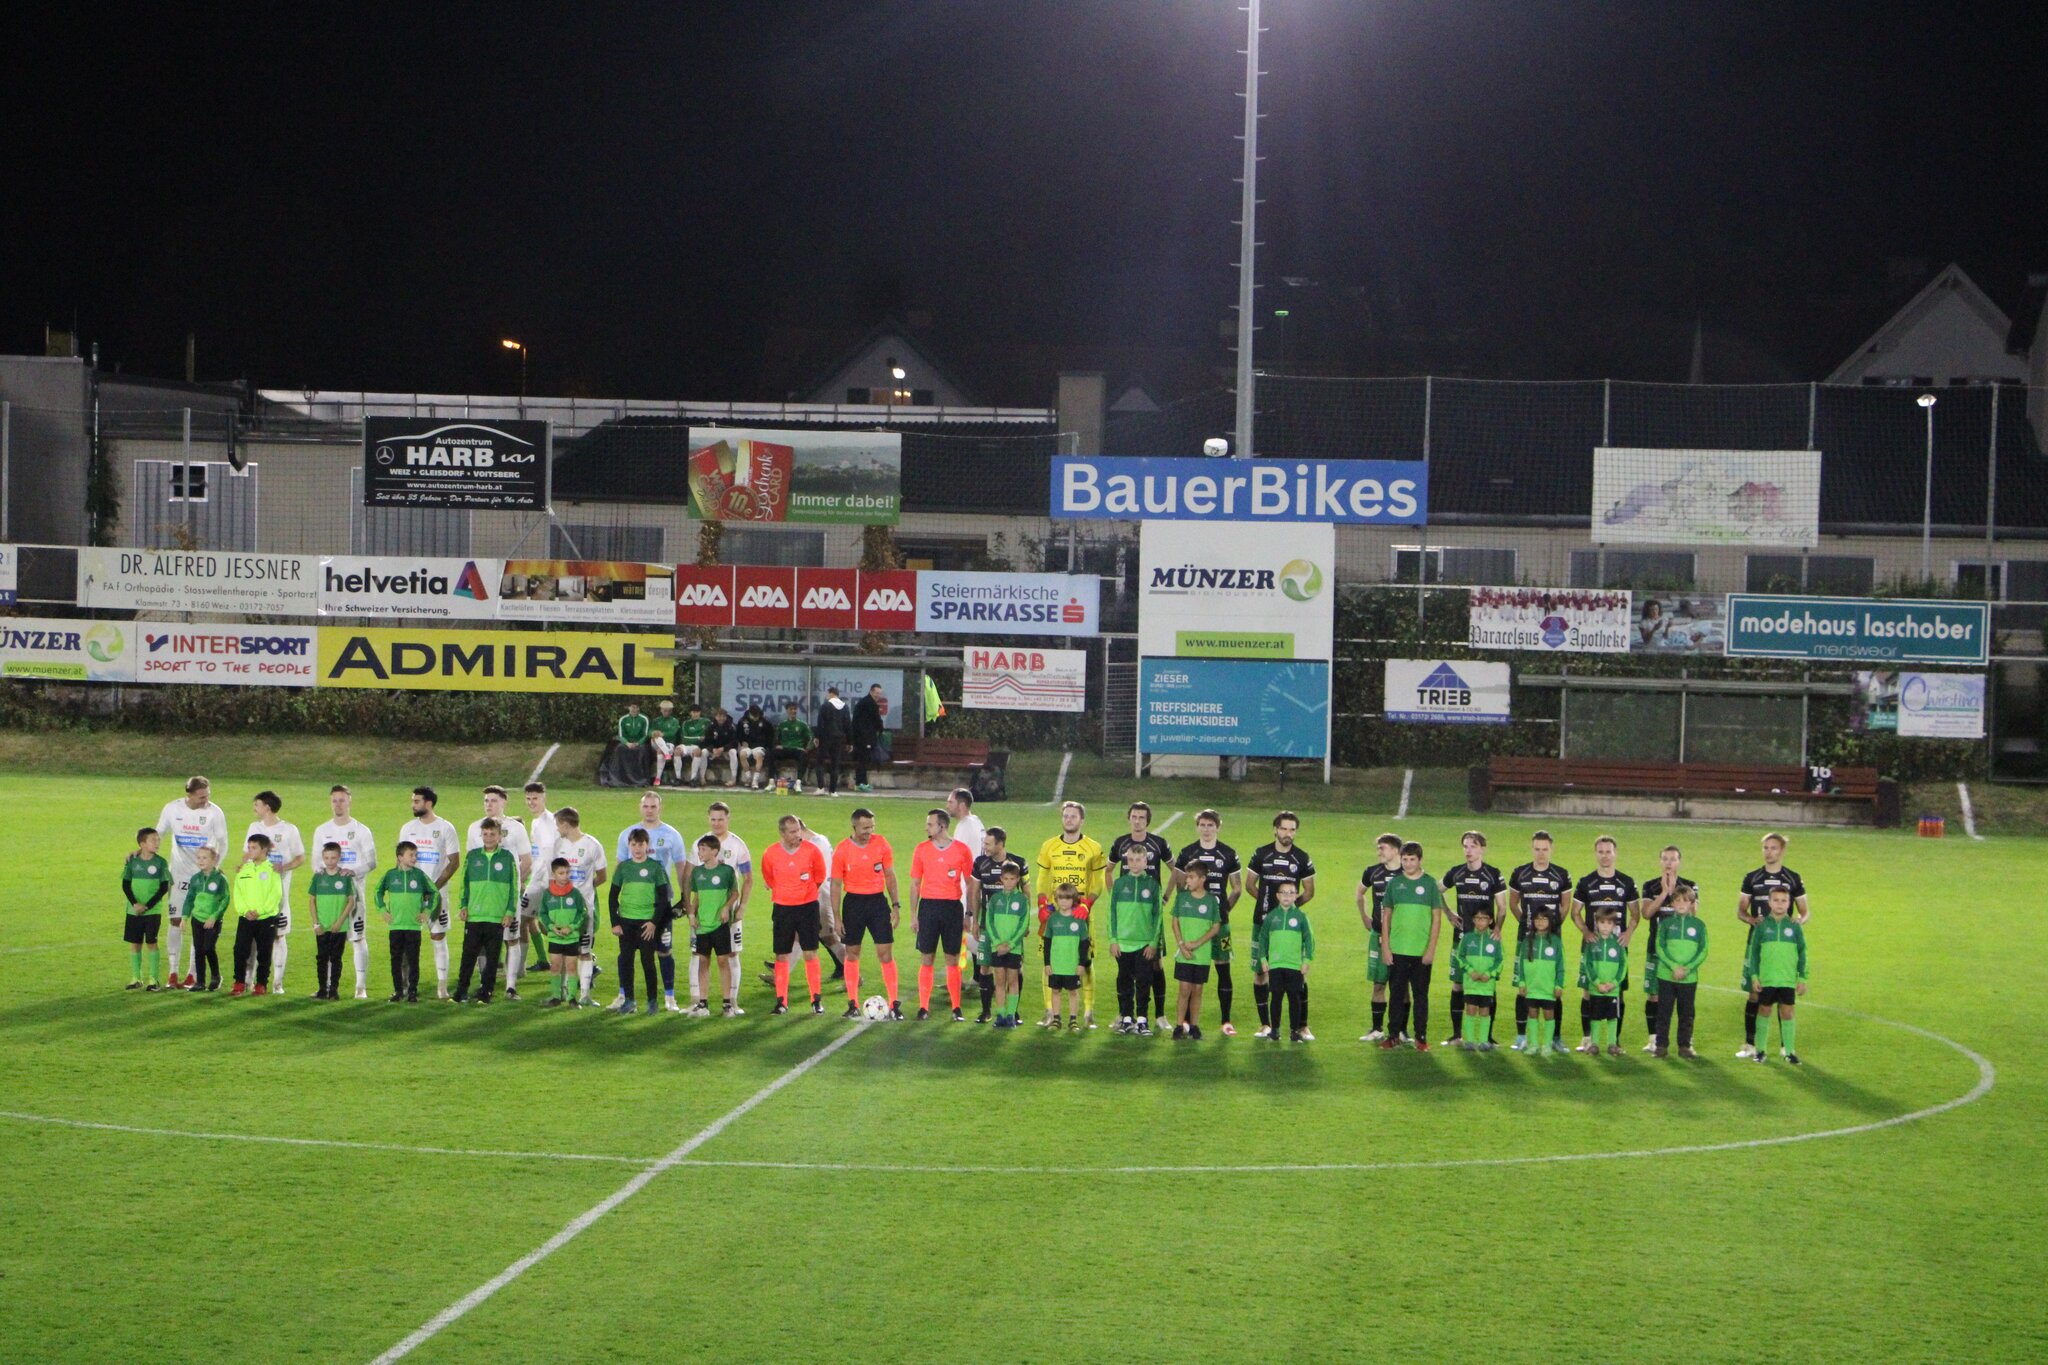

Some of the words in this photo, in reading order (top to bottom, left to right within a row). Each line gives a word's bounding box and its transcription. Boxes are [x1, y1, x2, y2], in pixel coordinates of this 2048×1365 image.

[435, 437, 492, 446] Autozentrum
[406, 446, 494, 467] HARB
[389, 468, 411, 476] WEIZ
[419, 469, 465, 477] GLEISDORF
[473, 470, 520, 479] VOITSBERG
[406, 481, 503, 491] www.autozentrum-harb.at
[1062, 462, 1418, 518] BauerBikes
[792, 492, 842, 507] Immer
[845, 494, 894, 509] dabei!
[120, 553, 148, 576] DR.
[153, 555, 217, 578] ALFRED
[224, 558, 301, 581] JESSNER
[325, 565, 448, 595] helvetia
[1150, 564, 1276, 590] MÜNZER
[103, 582, 115, 591] FA
[124, 582, 175, 594] Orthopädie
[277, 588, 318, 599] Sportarzt
[679, 583, 729, 608] ADA
[740, 585, 790, 608] ADA
[801, 587, 851, 610] ADA
[863, 588, 914, 612] ADA
[930, 582, 1060, 601] Steiermärkische
[325, 603, 343, 613] Ihre
[344, 604, 389, 615] Schweizer
[391, 605, 452, 616] Versicherung.
[929, 601, 1059, 623] SPARKASSE
[1739, 610, 1857, 637] modehaus
[1864, 612, 1973, 640] laschober
[173, 633, 311, 656] INTERSPORT
[1184, 638, 1285, 650] www.muenzer.at
[1470, 624, 1540, 648] Paracelsus
[1569, 627, 1628, 650] Apotheke
[1812, 643, 1898, 658] menswear
[7, 664, 83, 676] www.muenzer.at
[144, 659, 192, 672] SPORT
[195, 660, 217, 673] TO
[222, 661, 251, 674] THE
[258, 662, 312, 675] PEOPLE
[327, 636, 665, 687] ADMIRAL
[972, 650, 1046, 671] HARB
[736, 675, 863, 693] Steiermäkische
[1153, 673, 1190, 683] ZIESER
[1416, 688, 1472, 706] TRIEB
[1149, 701, 1223, 714] TREFFSICHERE
[1149, 714, 1239, 727] GESCHENKSIDEEN
